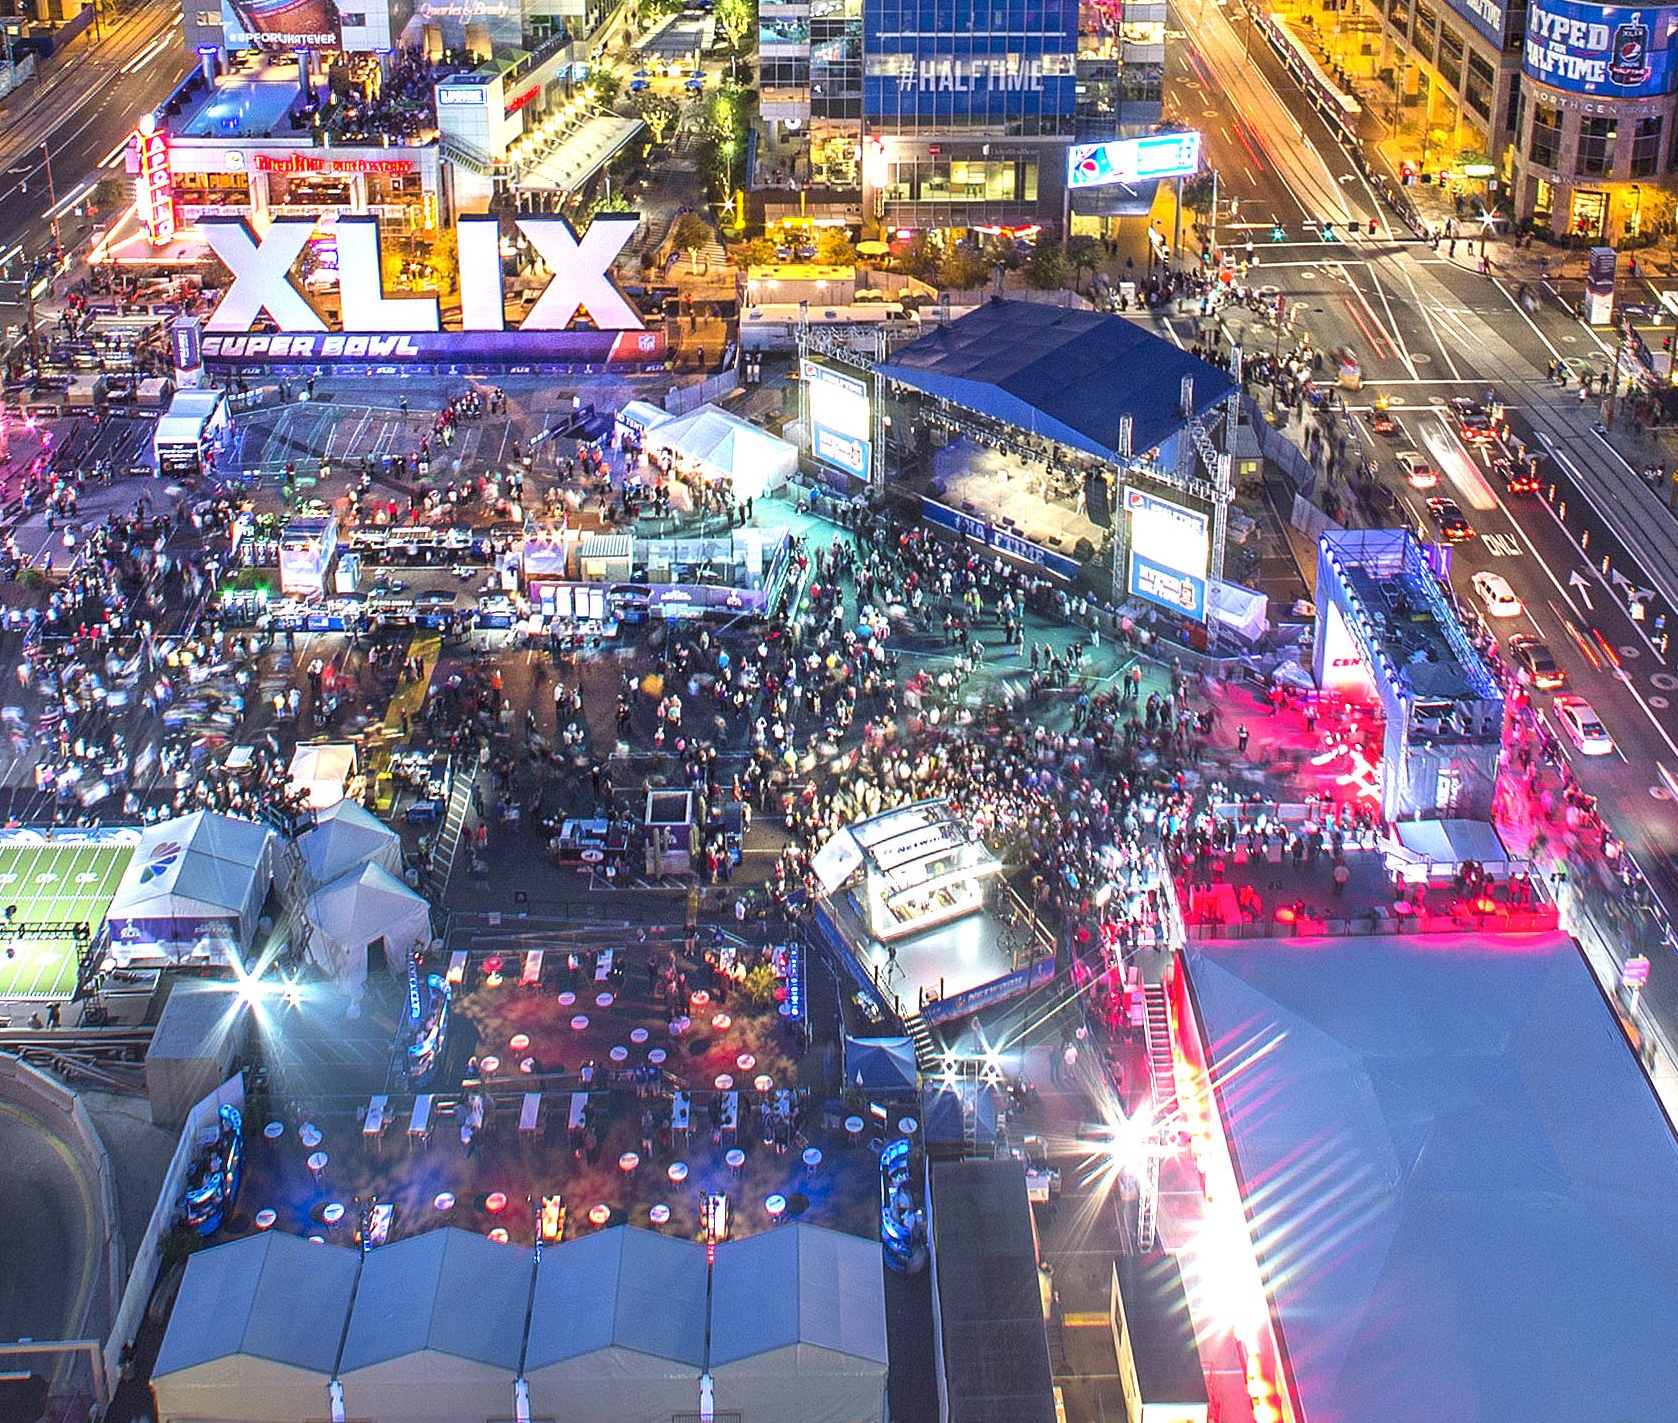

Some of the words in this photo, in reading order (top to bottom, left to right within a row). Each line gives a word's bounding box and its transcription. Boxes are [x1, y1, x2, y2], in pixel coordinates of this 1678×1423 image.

[474, 2, 509, 17] Brady
[1531, 4, 1610, 51] HYPED
[897, 58, 1045, 92] #HALFTIME
[1533, 90, 1579, 109] NORTH
[1584, 104, 1658, 115] CENRAL
[194, 212, 646, 331] XLIX
[201, 336, 317, 357] SUPER
[321, 335, 420, 357] BOWL
[954, 515, 1045, 565] #HAFTIME
[1481, 533, 1523, 556] ONLY
